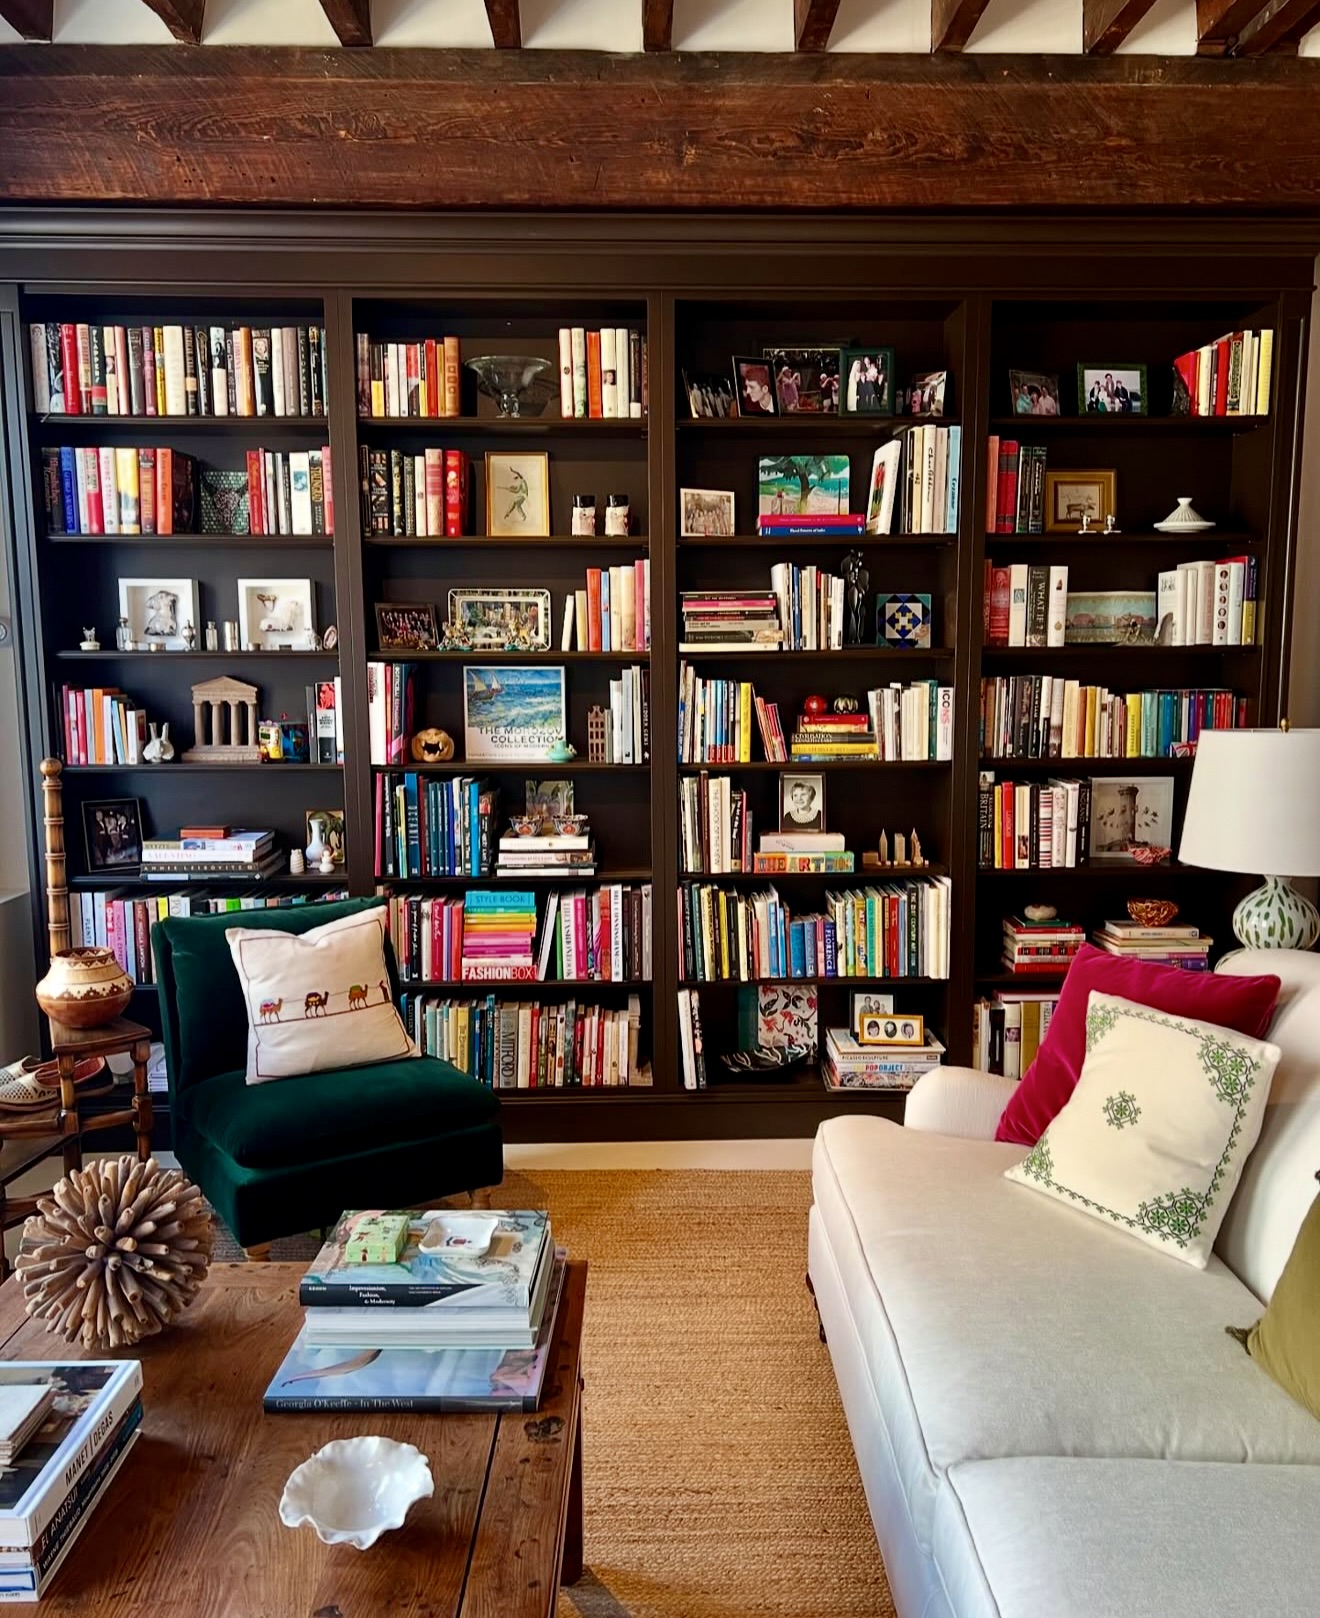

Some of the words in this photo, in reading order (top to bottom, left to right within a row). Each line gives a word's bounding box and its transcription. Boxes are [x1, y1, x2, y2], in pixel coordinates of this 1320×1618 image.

[1037, 581, 1046, 612] WHAT
[1036, 613, 1045, 623] IF
[942, 689, 951, 725] ICONS
[480, 726, 501, 735] THE
[504, 726, 561, 736] MOROZOV
[407, 805, 418, 846] OCEANIA
[979, 793, 989, 829] BRITAIN
[788, 857, 824, 871] ART
[475, 895, 497, 904] STYLE
[825, 929, 833, 961] FLORENCE
[501, 1031, 516, 1078] MITFORD
[349, 1285, 387, 1293] Impressionism,
[275, 1399, 312, 1409] Georgia
[313, 1398, 352, 1408] O'Keeffe
[360, 1399, 370, 1408] In
[370, 1399, 390, 1408] The
[391, 1399, 414, 1408] West
[65, 1447, 90, 1487] MANET
[93, 1410, 114, 1446] DEGAS
[50, 1486, 79, 1533] ANATSUI
[42, 1540, 60, 1570] WAYNE
